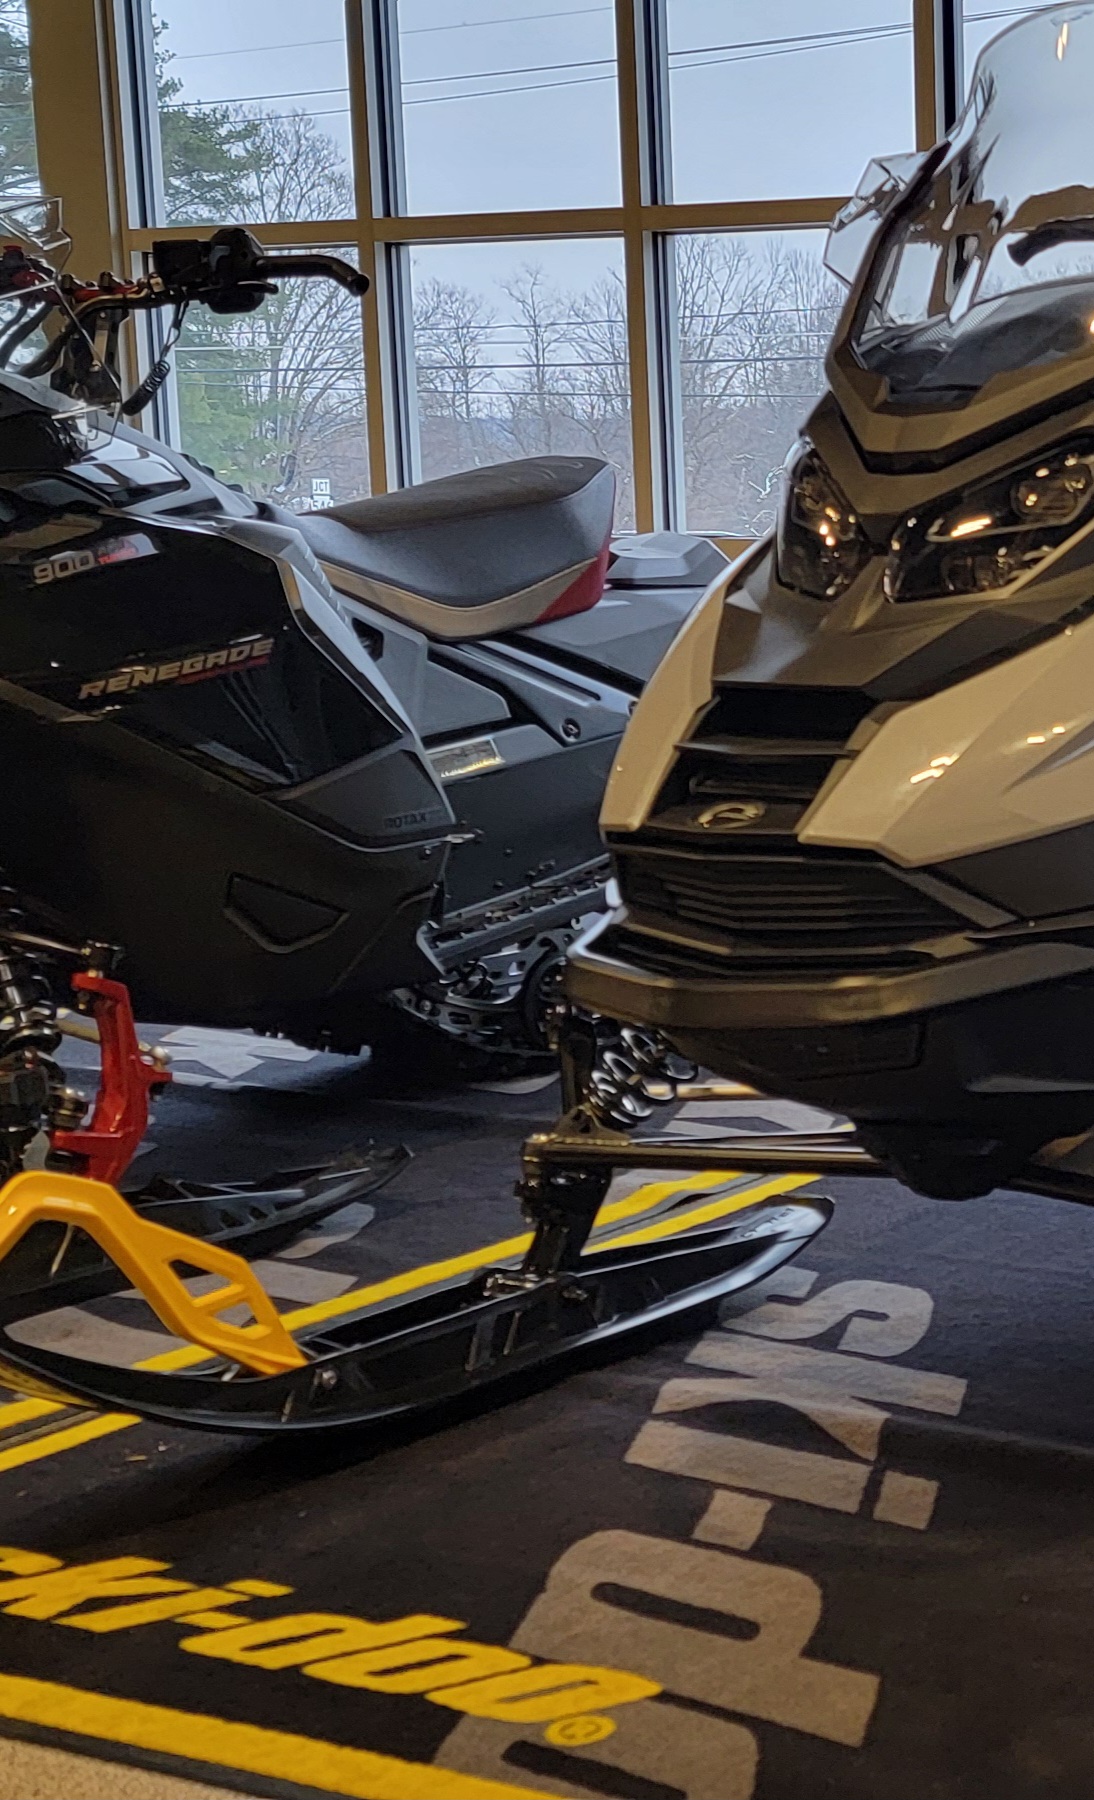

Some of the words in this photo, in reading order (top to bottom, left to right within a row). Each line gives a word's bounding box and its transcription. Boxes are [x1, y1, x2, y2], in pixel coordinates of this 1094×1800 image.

[313, 480, 329, 493] JCT
[33, 550, 97, 585] 900
[78, 638, 275, 700] RENEGADE
